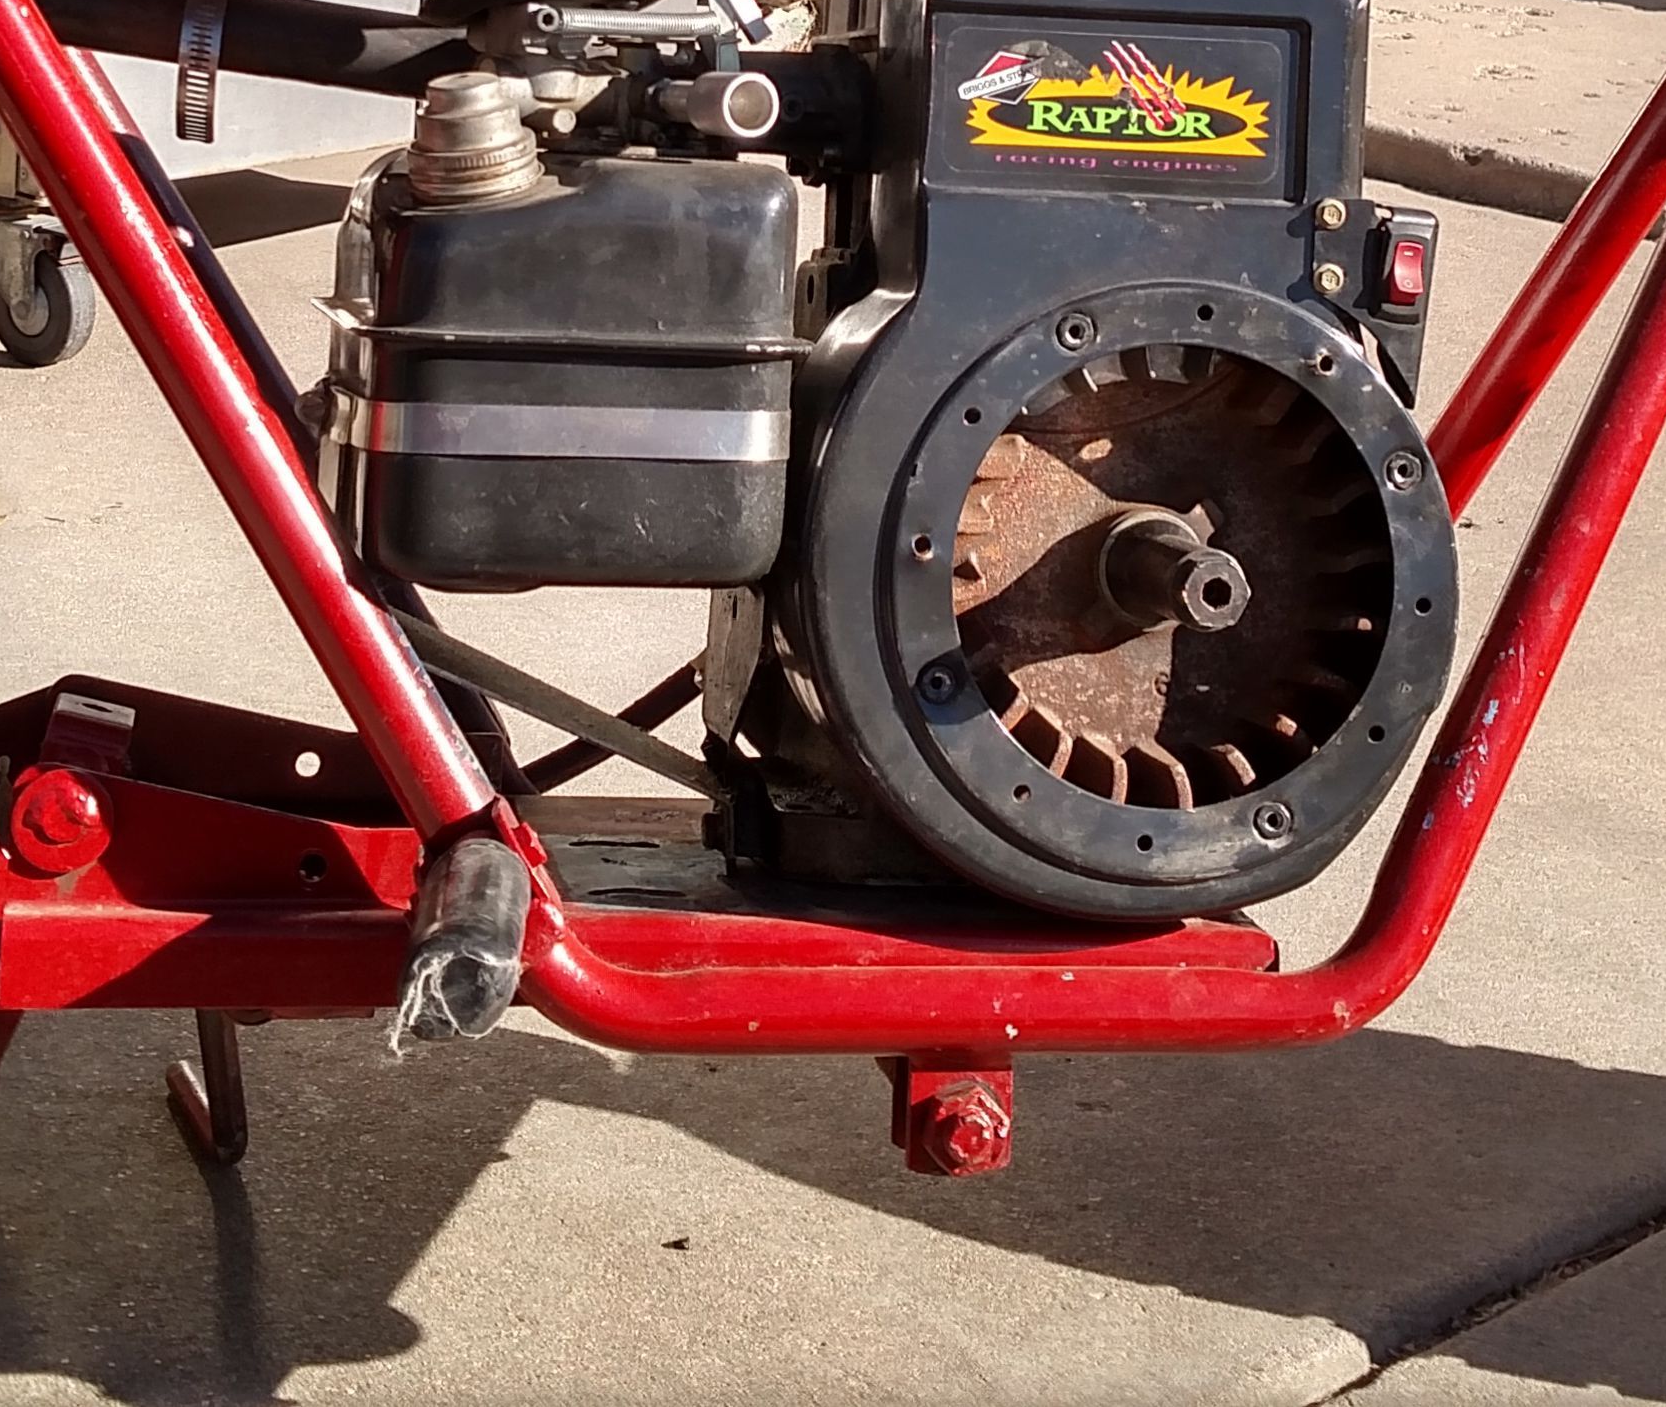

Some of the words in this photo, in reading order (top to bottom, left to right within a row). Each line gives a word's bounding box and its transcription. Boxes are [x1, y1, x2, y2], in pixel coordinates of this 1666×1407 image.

[963, 78, 997, 96] BRIGGS
[1026, 100, 1216, 140] RAPTOR
[994, 152, 1097, 169] racing
[1112, 155, 1238, 173] engines
